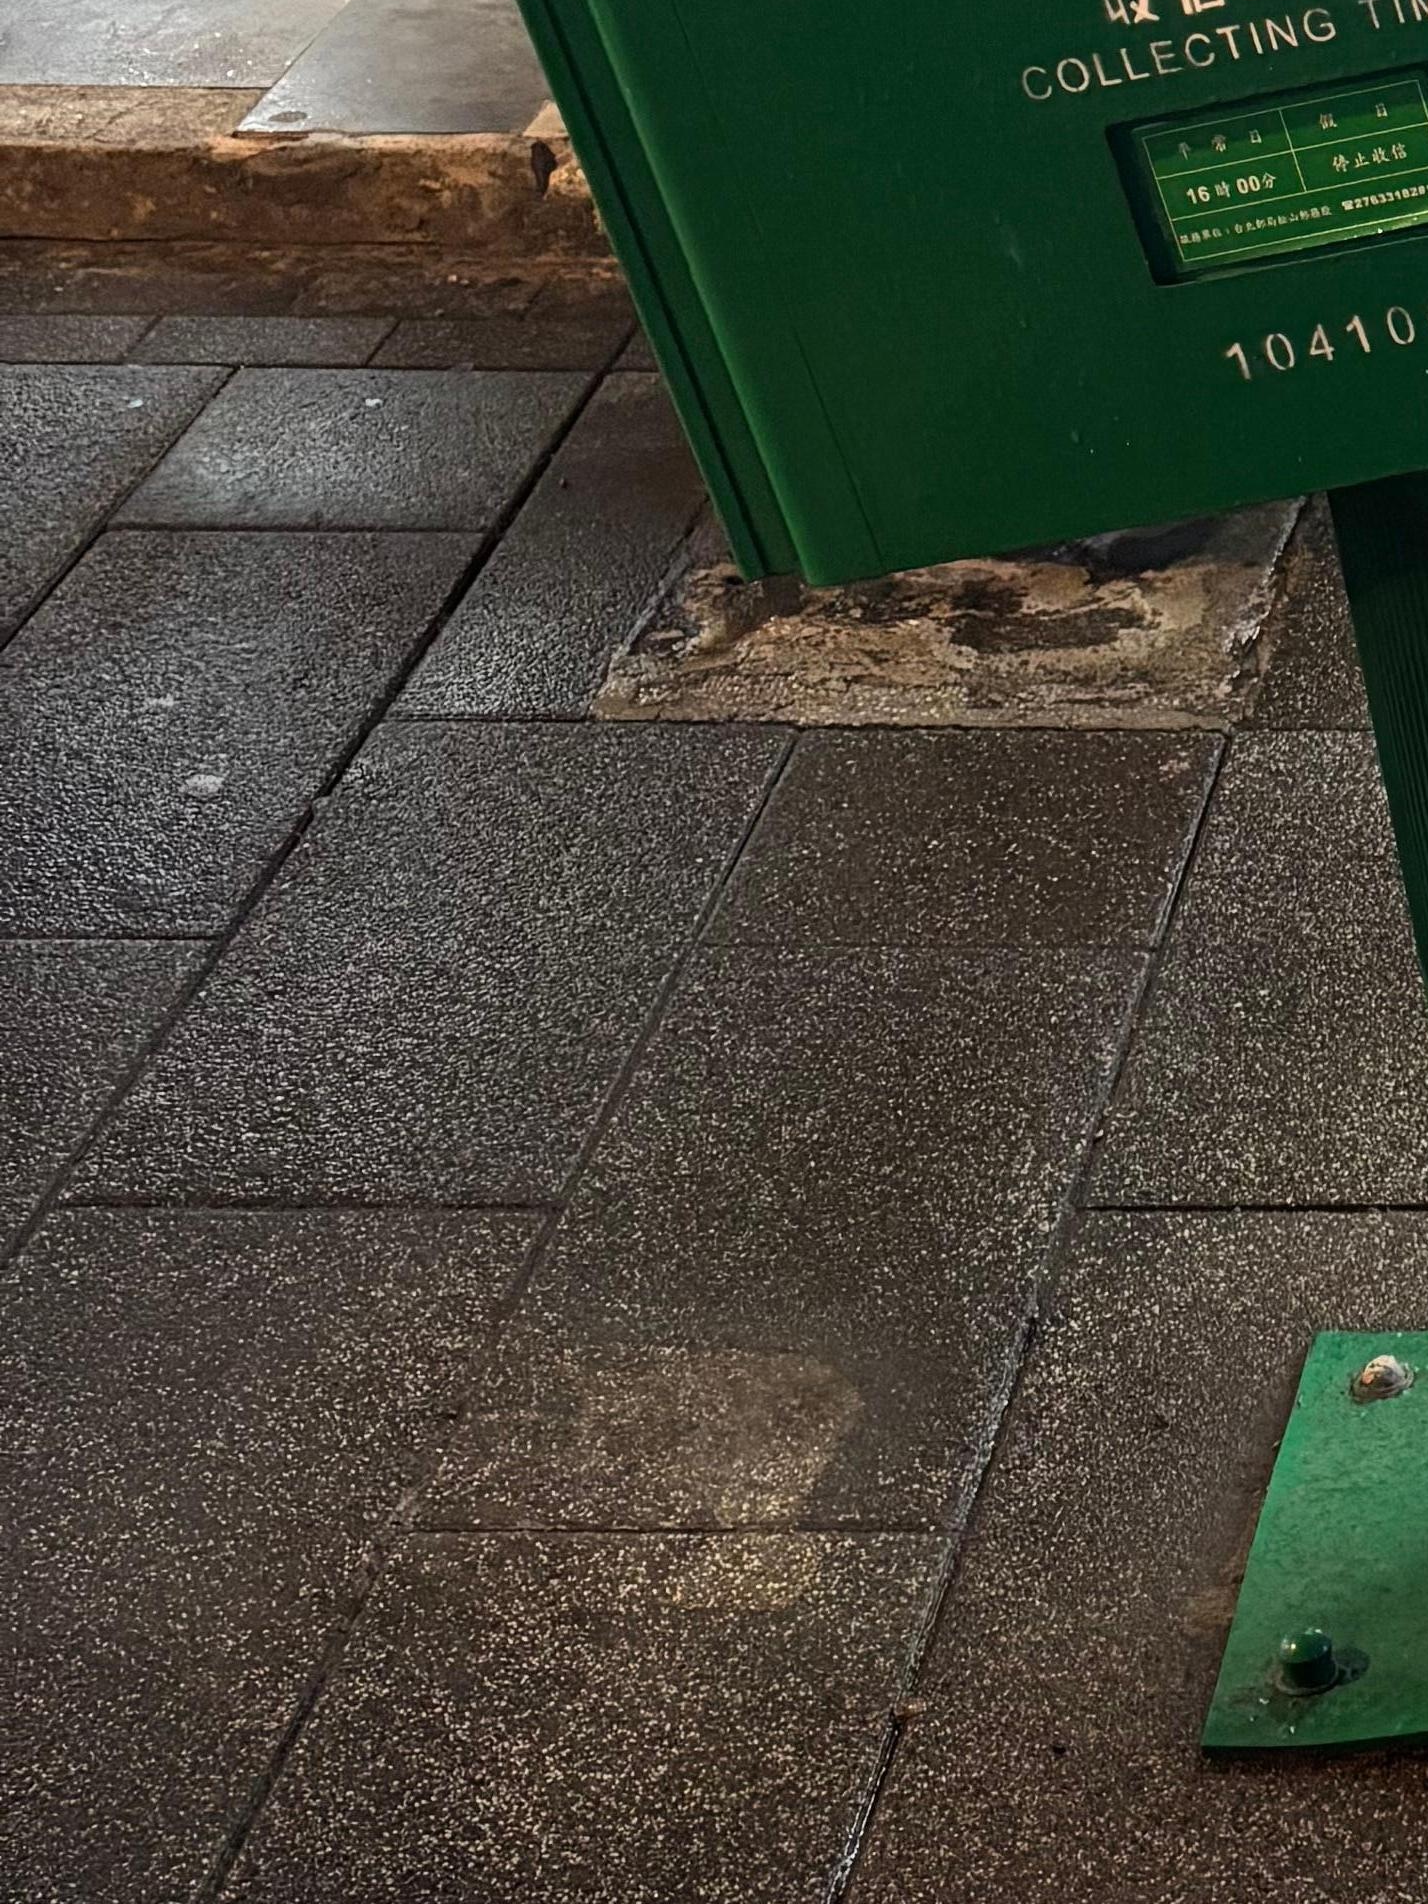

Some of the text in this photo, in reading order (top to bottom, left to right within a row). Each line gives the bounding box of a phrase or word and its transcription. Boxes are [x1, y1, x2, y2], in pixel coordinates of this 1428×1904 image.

[1022, 6, 1338, 100] COLLECTING
[1332, 142, 1408, 173] 停止收信
